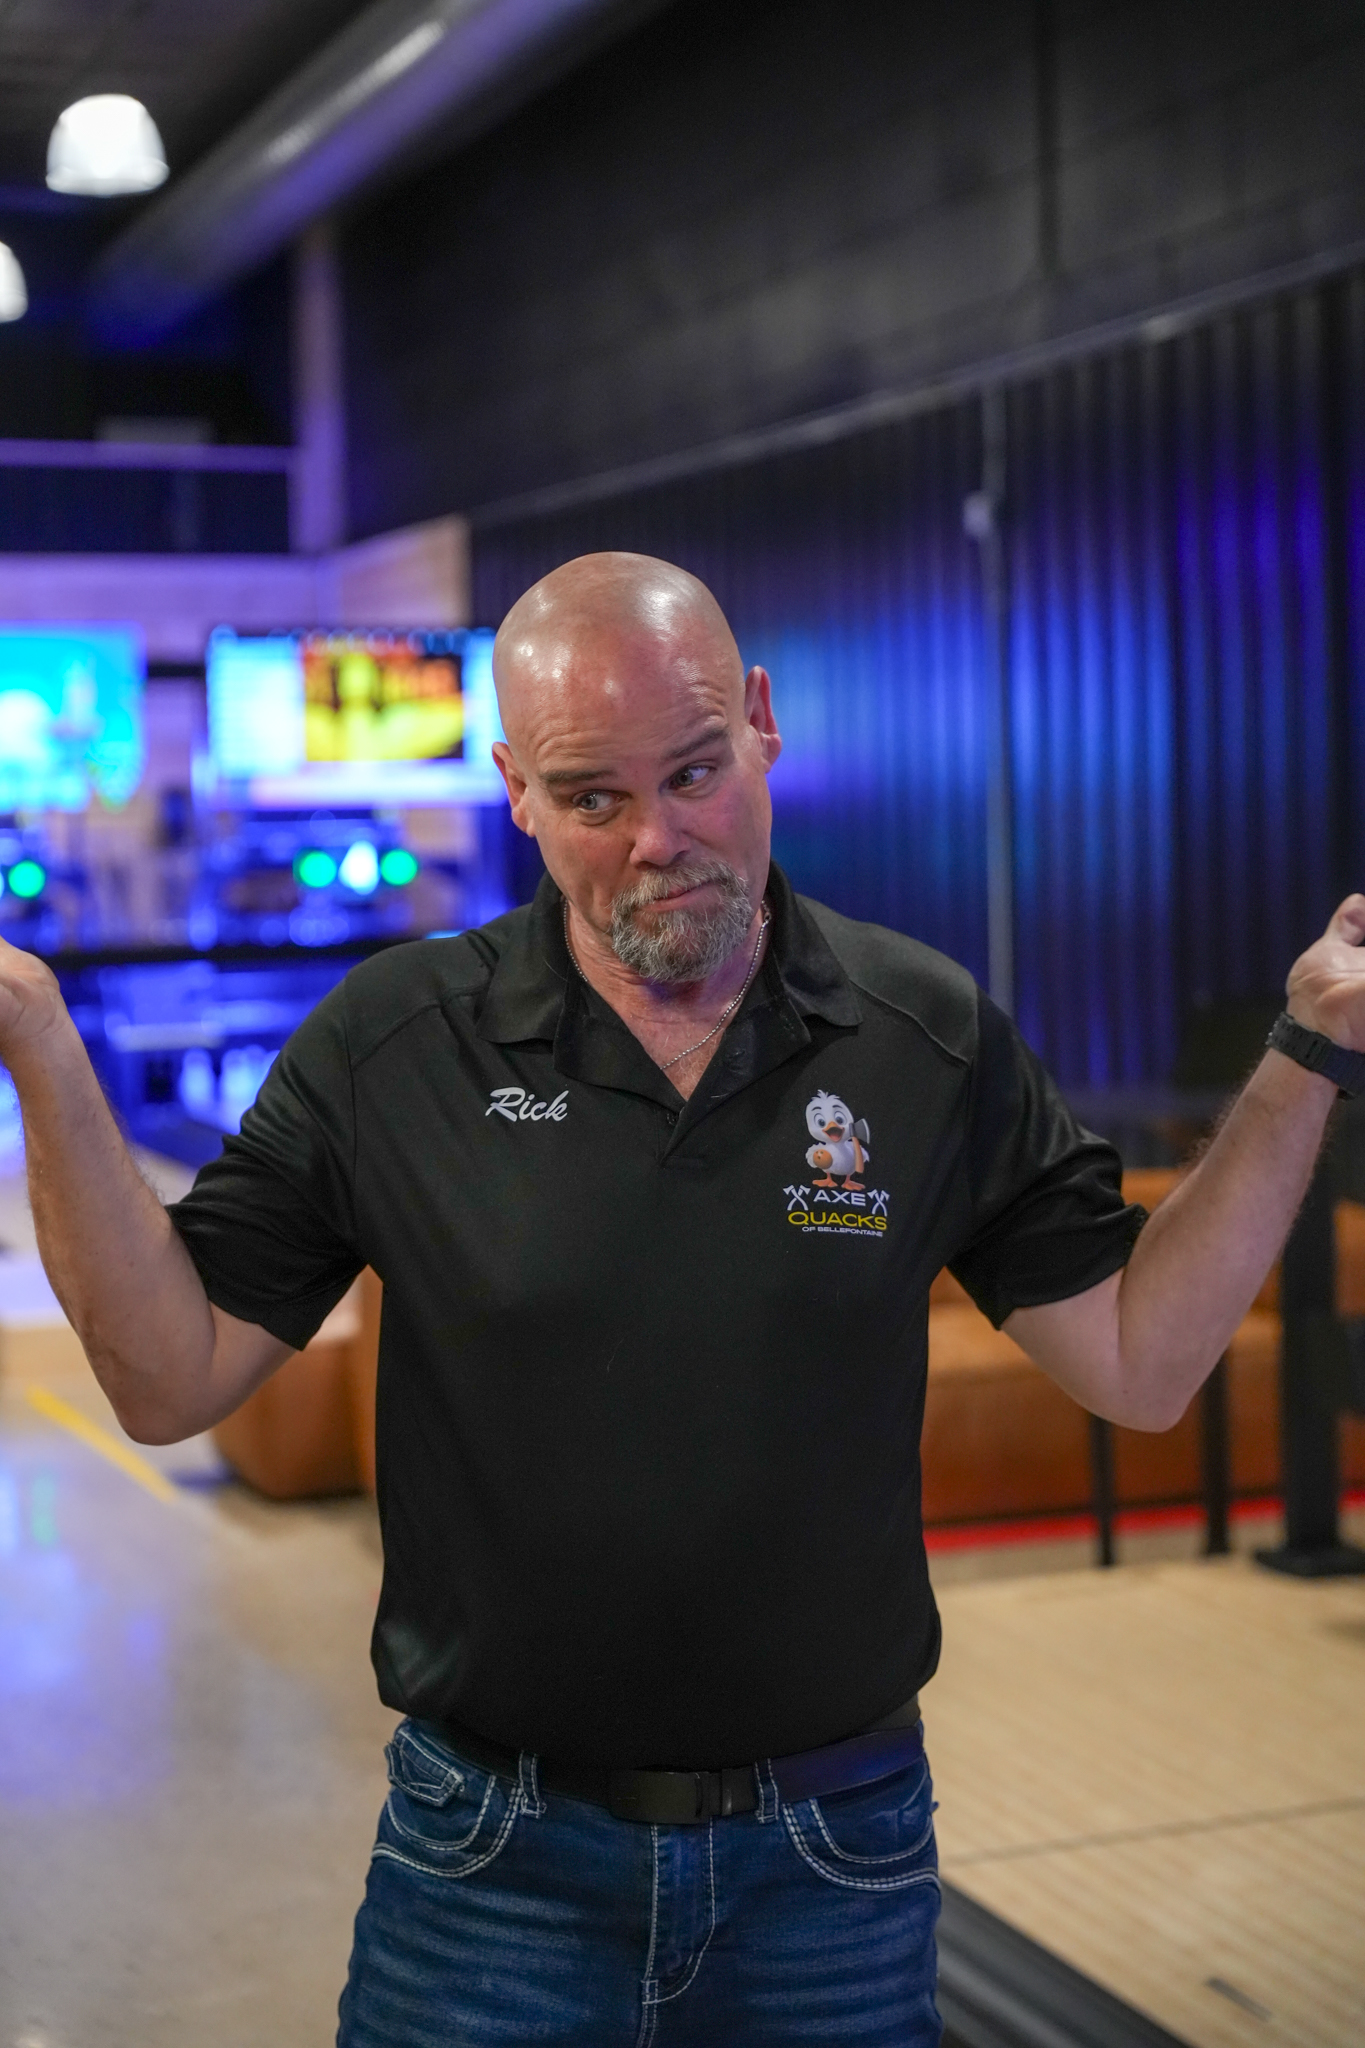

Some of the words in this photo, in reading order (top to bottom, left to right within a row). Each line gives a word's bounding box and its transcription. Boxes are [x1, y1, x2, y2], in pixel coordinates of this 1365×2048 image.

[485, 1087, 569, 1122] Rick
[813, 1189, 866, 1206] AXE
[788, 1211, 887, 1231] QUACKS
[817, 1226, 883, 1237] BELLEFONTAINE
